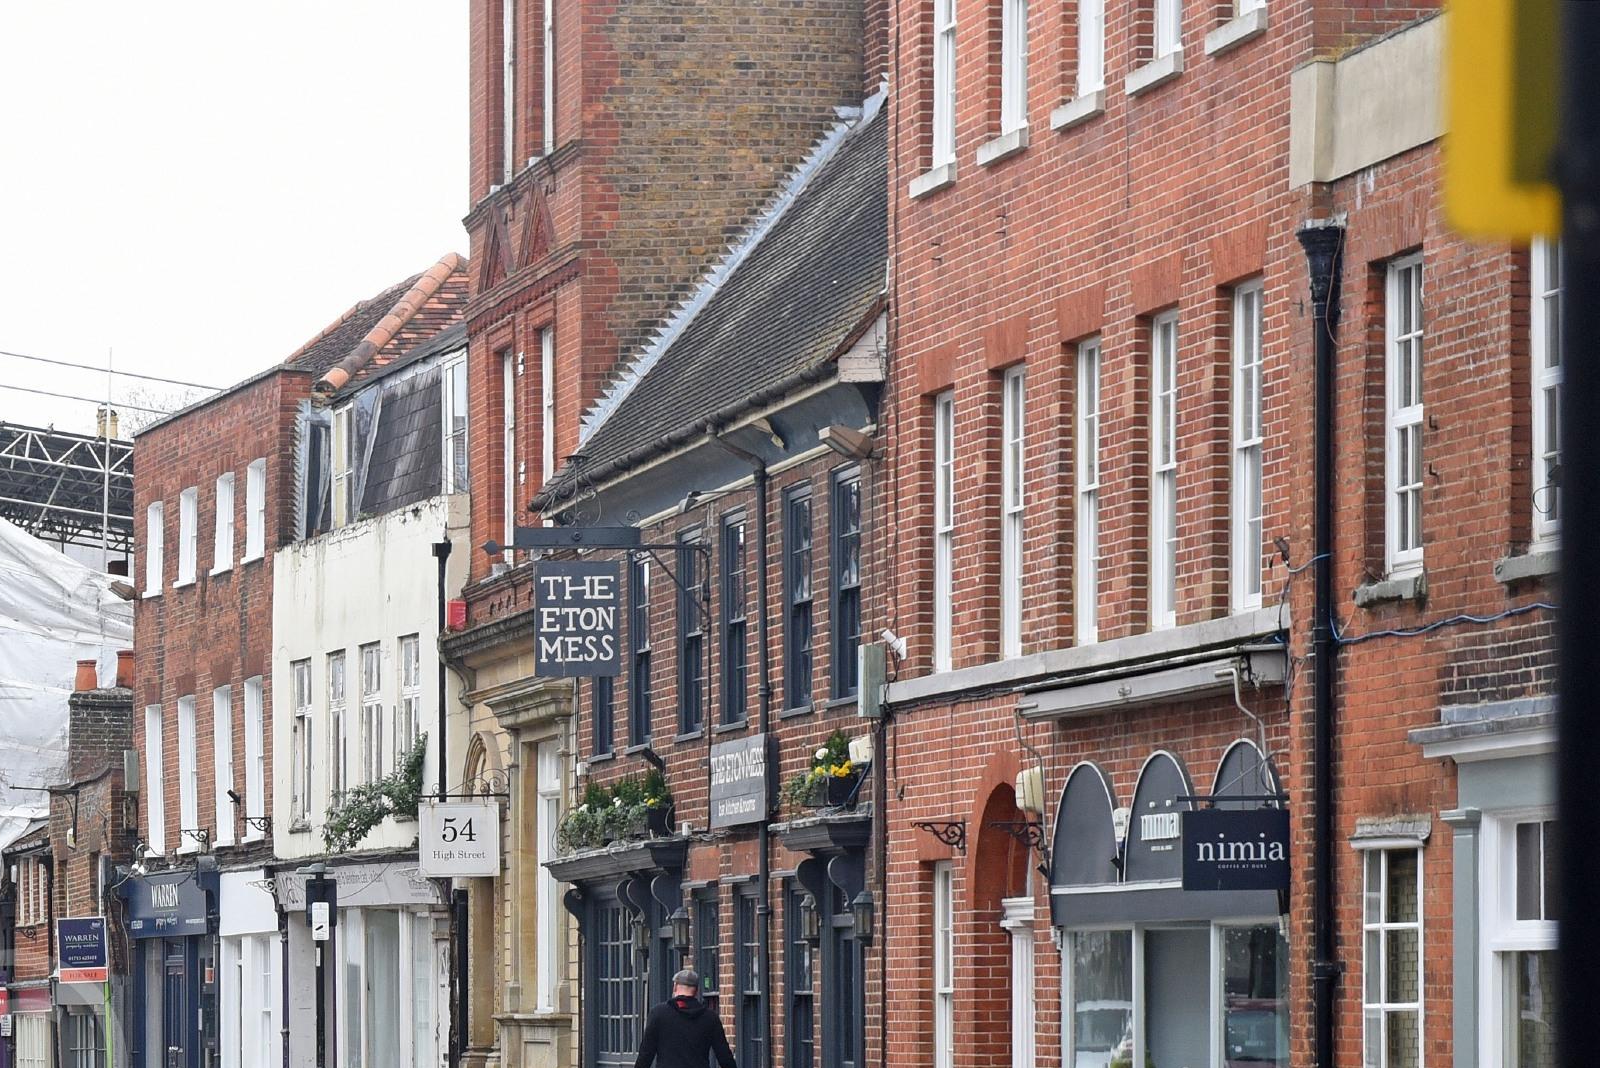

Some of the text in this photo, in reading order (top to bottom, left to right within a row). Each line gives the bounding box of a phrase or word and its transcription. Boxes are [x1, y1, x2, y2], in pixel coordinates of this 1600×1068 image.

[540, 575, 614, 601] THE
[539, 606, 614, 632] ETON
[539, 634, 614, 663] MESS
[711, 746, 764, 786] THE ETON MESS
[442, 817, 477, 843] 54
[433, 850, 486, 861] High Street
[1196, 832, 1286, 862] nimia
[151, 883, 179, 908] WARREN
[64, 933, 99, 942] WARREN
